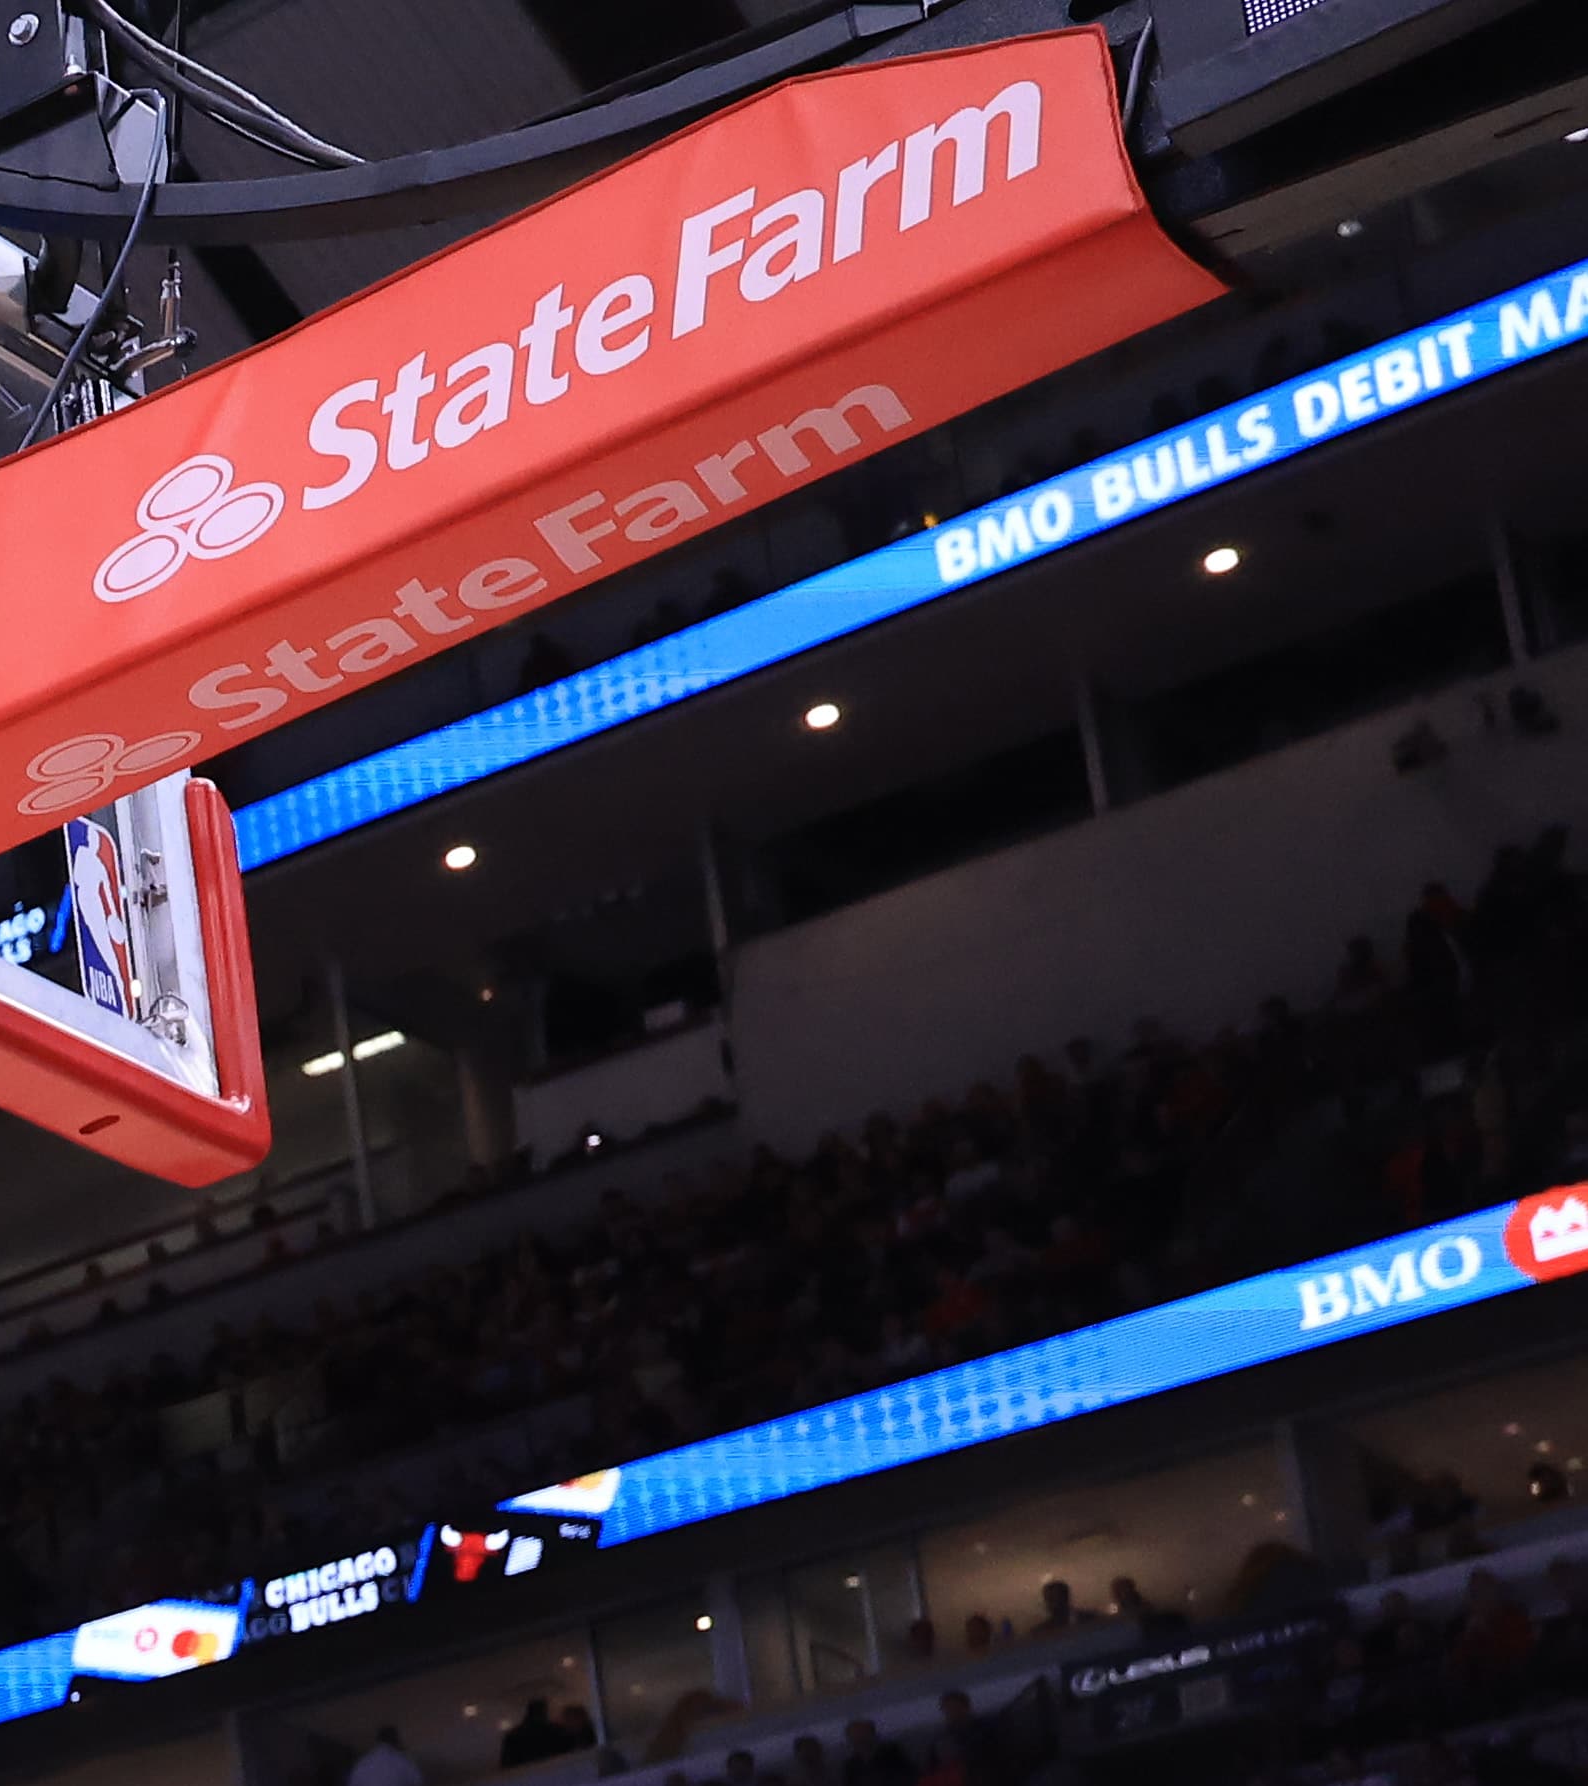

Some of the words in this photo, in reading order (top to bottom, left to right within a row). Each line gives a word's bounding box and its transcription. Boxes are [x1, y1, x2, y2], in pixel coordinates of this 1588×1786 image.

[934, 488, 1074, 584] BMO
[1090, 403, 1279, 521] BULLS
[1292, 321, 1476, 439] DEBIT
[89, 966, 119, 1008] NBA
[1298, 1235, 1483, 1331] BMO
[264, 1546, 397, 1608] CHICAGO
